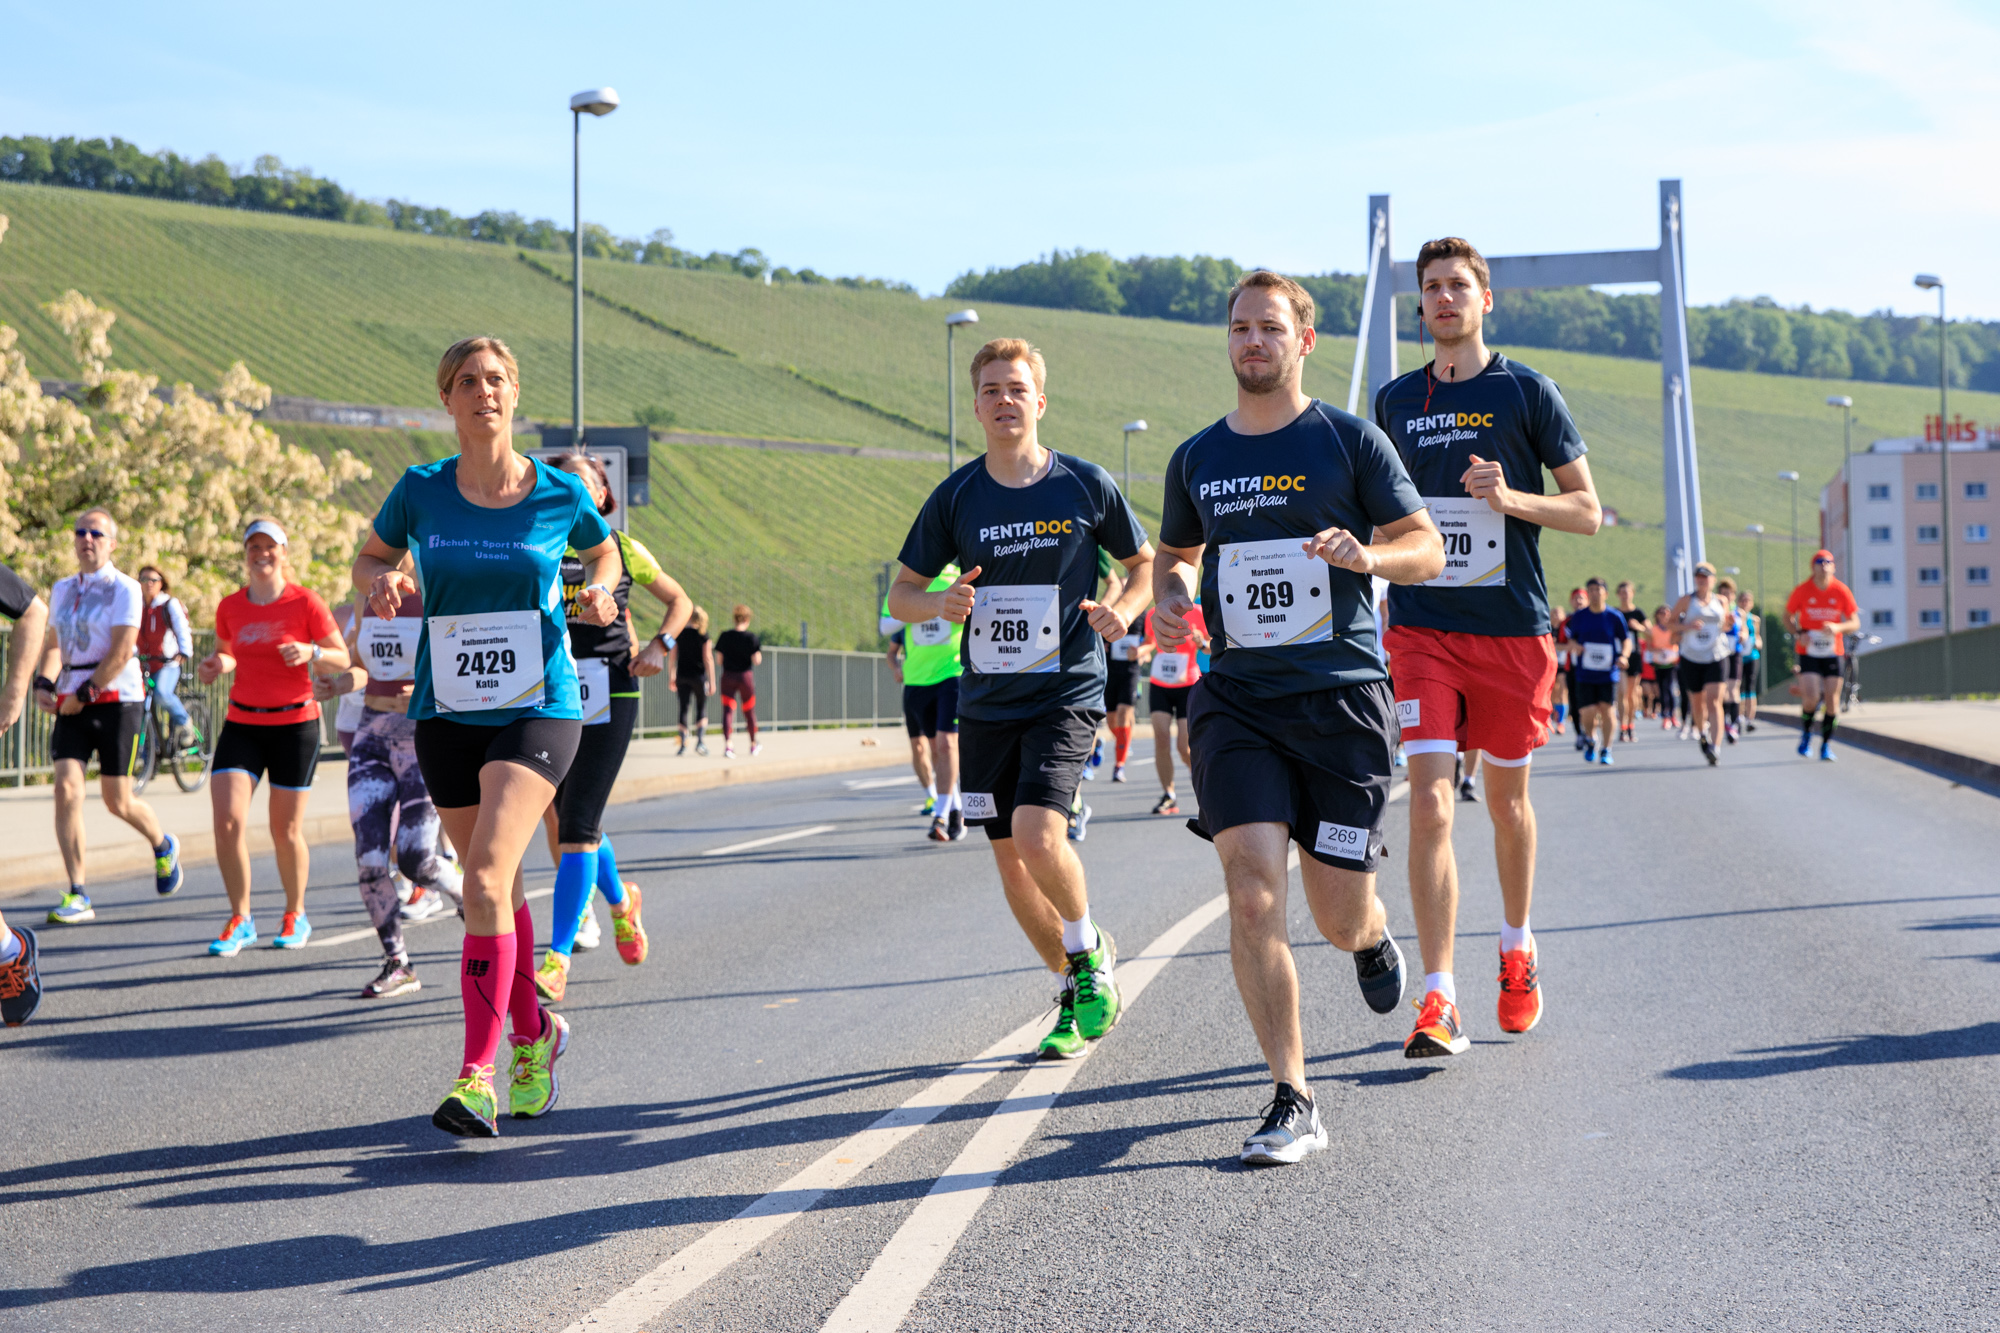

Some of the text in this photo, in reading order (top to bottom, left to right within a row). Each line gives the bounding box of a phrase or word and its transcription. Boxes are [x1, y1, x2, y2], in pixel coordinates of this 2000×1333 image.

[1406, 412, 1494, 434] PENTADOC
[1925, 413, 1977, 442] ibis
[1199, 475, 1306, 500] PENTADOC
[980, 519, 1072, 542] PENTADOC
[440, 539, 470, 547] Schuh
[482, 540, 510, 549] Sport
[1445, 559, 1469, 567] arkus
[1251, 567, 1284, 577] Marathon
[1246, 580, 1294, 610] 269
[1257, 613, 1286, 624] Simon
[990, 620, 1029, 642] 268
[462, 637, 508, 646] Halbmarathon
[370, 642, 403, 658] 1024
[998, 645, 1021, 654] Niklas
[456, 649, 516, 677] 2429
[476, 679, 499, 689] Katja
[967, 796, 986, 807] 268
[1328, 827, 1357, 845] 269
[1317, 841, 1363, 856] Simon Joseph
